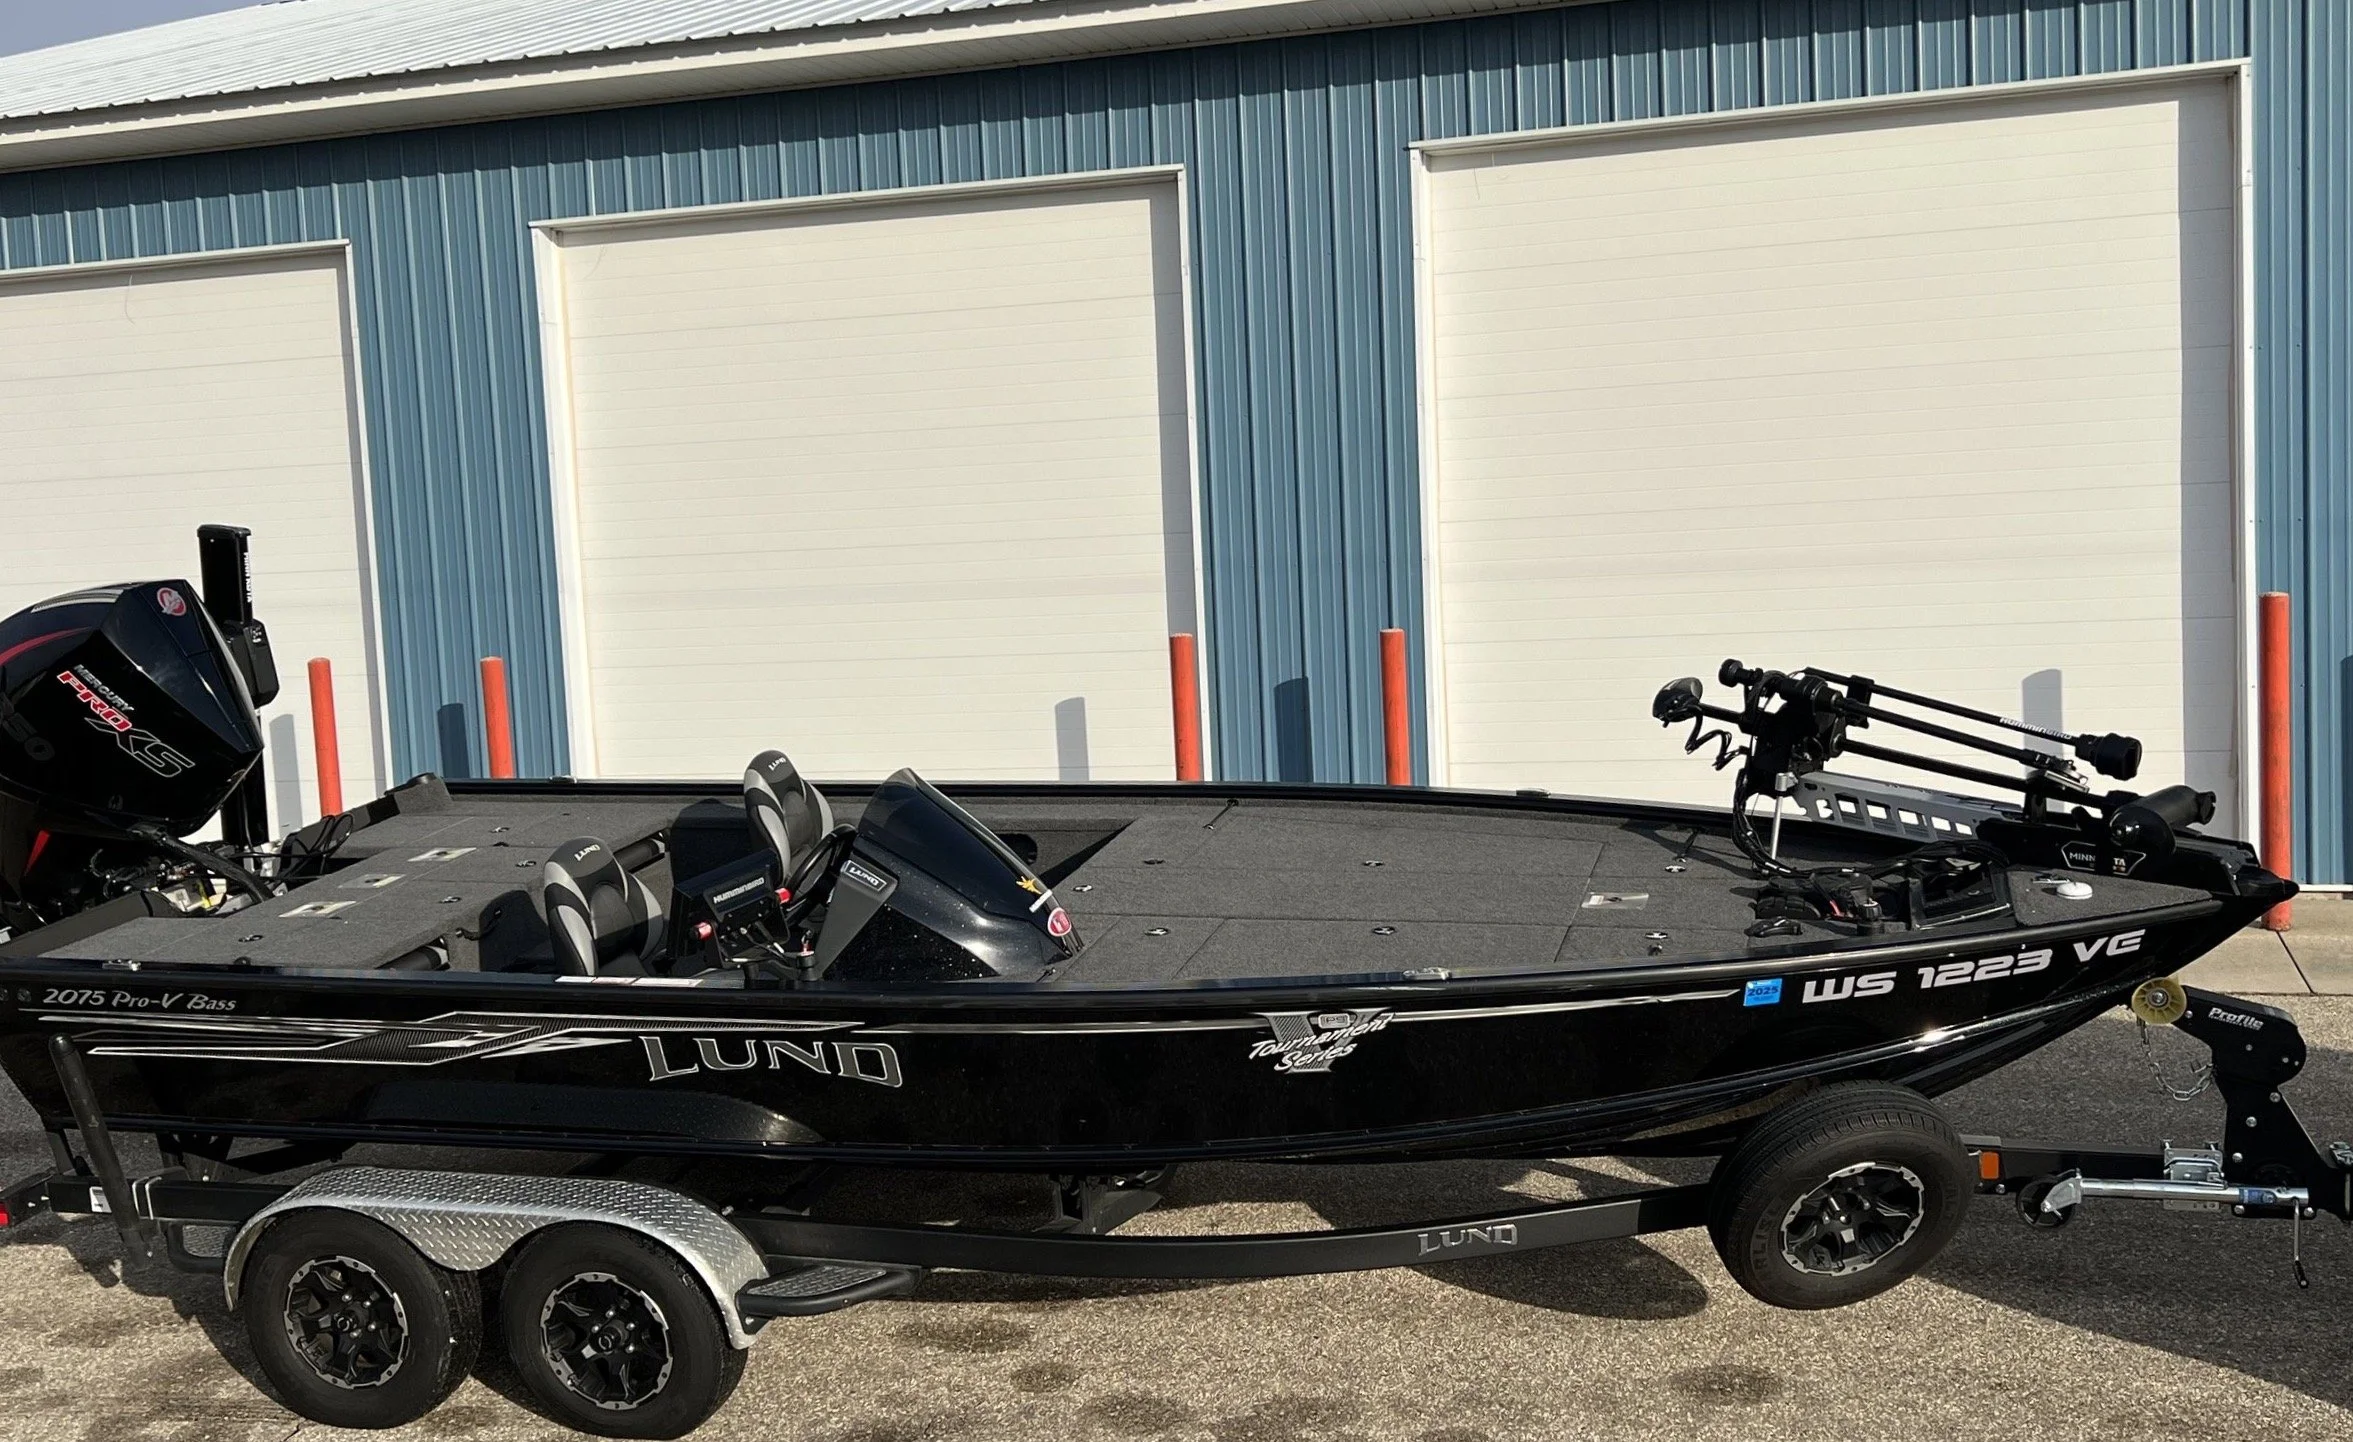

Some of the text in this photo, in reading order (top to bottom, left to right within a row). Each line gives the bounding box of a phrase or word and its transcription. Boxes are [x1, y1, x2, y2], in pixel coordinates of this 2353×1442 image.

[56, 670, 132, 732] PRO
[73, 664, 134, 712] MERCURY
[84, 717, 196, 778] XS
[767, 755, 787, 771] LUND
[574, 843, 601, 862] LUND
[2069, 852, 2096, 863] MINN
[713, 876, 765, 905] HUMMINBIRD
[849, 867, 879, 886] LUND
[1802, 929, 2146, 1004] WS 1223 VE
[43, 988, 237, 1012] 2075 Pro-V Bass
[1747, 985, 1779, 997] 2025
[2208, 1007, 2264, 1029] Profile
[1248, 1012, 1396, 1060] Tournament
[638, 1034, 904, 1089] LUND
[1273, 1043, 1358, 1071] Series
[1418, 1223, 1518, 1257] LUND
